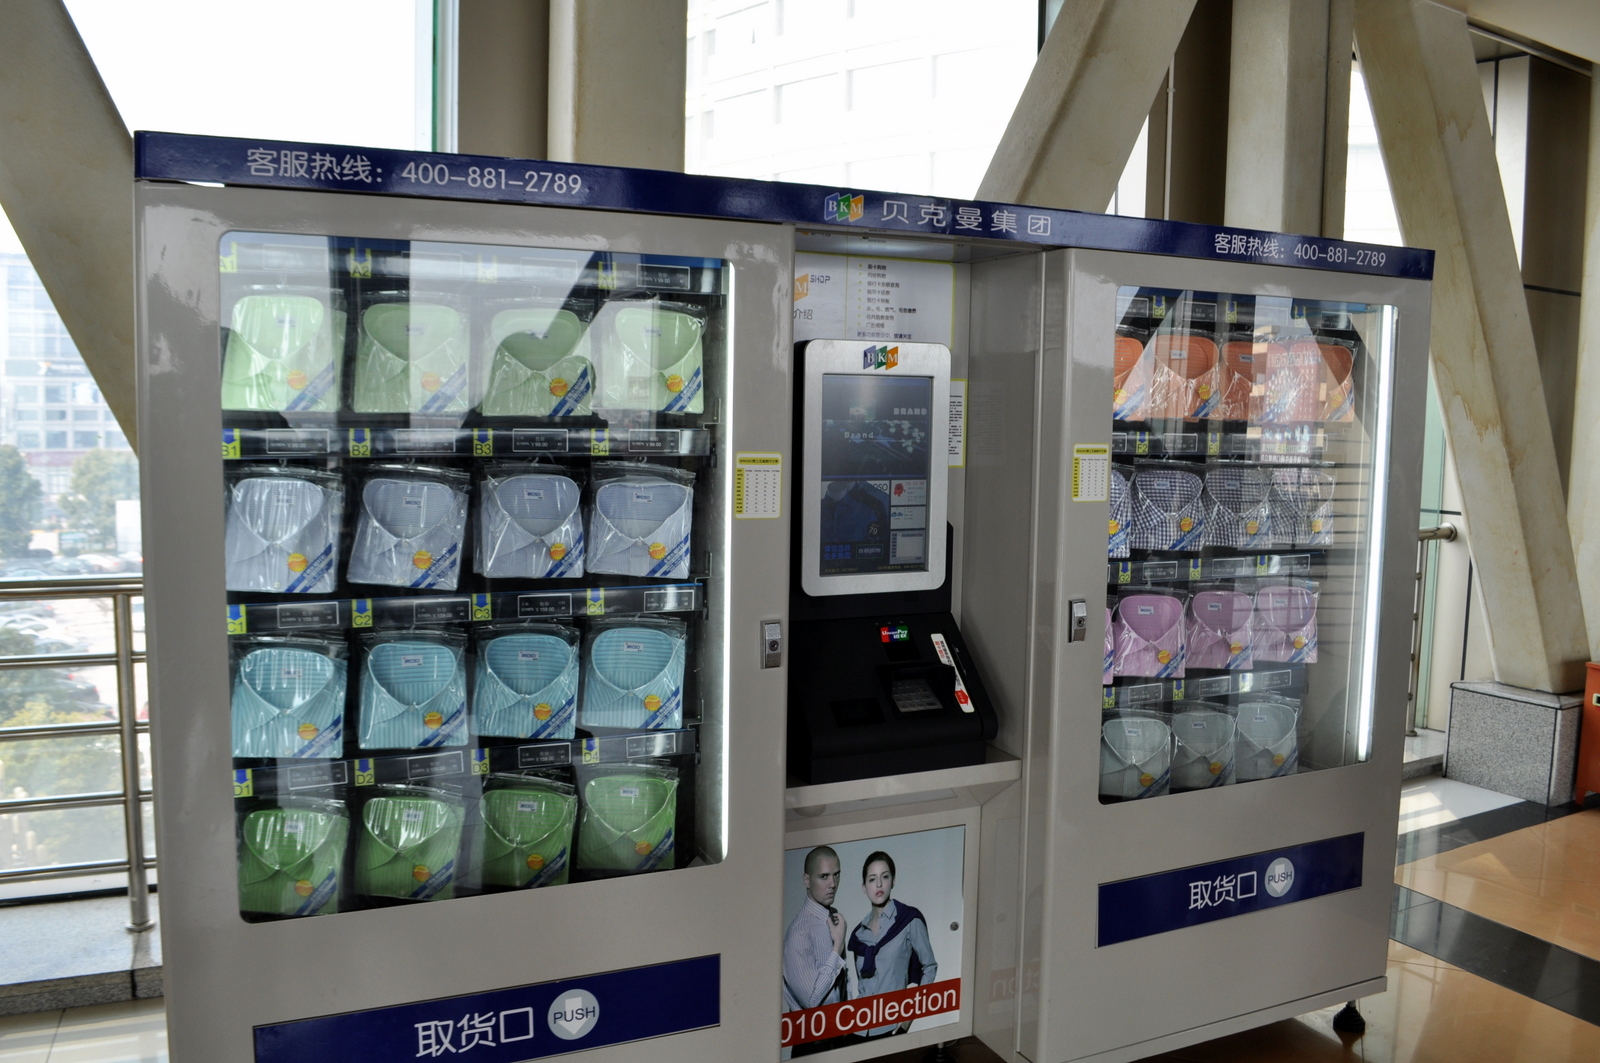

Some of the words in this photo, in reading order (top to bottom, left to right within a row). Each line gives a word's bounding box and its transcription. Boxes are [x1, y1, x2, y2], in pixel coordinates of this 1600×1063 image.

[246, 148, 382, 185] 客服热线：
[401, 162, 582, 196] 400-881-2789
[826, 199, 864, 218] BKM
[881, 199, 1052, 237] 贝克曼集团
[1294, 243, 1386, 268] 400-881-2789
[352, 265, 370, 277] A2
[810, 274, 831, 284] SHOP
[1153, 307, 1164, 317] E2
[865, 351, 899, 364] BKM
[893, 407, 927, 416] BRAND
[844, 431, 874, 439] Brand
[222, 445, 237, 456] B1
[352, 445, 368, 456] B2
[475, 443, 491, 455] B3
[592, 443, 608, 454] B4
[1138, 444, 1148, 453] F2
[868, 526, 878, 536] 79
[1119, 574, 1130, 583] G2
[474, 608, 490, 619] C3
[588, 603, 603, 613] C4
[353, 614, 371, 626] C2
[226, 622, 243, 633] C1
[1173, 691, 1184, 700] H3
[584, 751, 598, 762] D4
[472, 763, 488, 774] D3
[356, 773, 373, 785] D2
[233, 785, 250, 796] D1
[1267, 870, 1293, 886] PUSH
[1188, 871, 1257, 910] 取货口
[553, 1004, 597, 1025] PUSH
[835, 988, 957, 1032] Collection
[414, 1006, 534, 1058] 取货口
